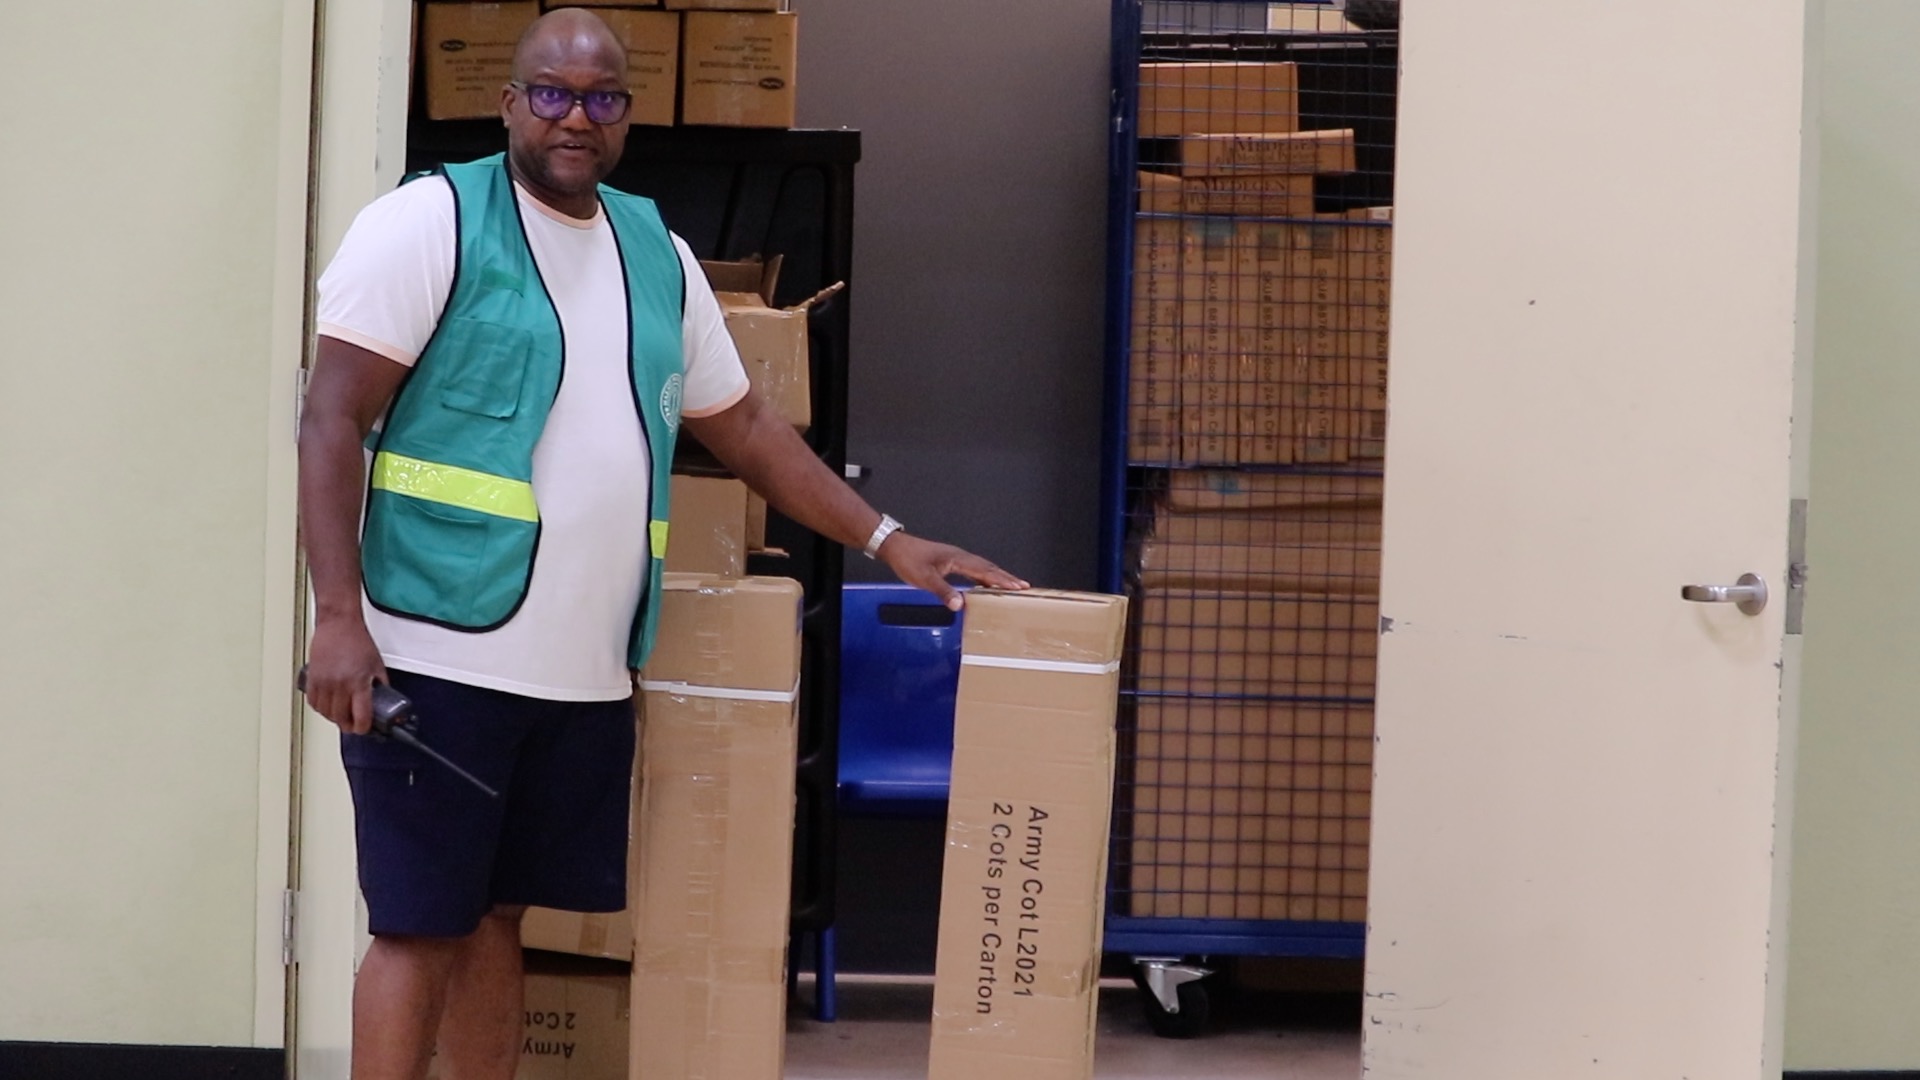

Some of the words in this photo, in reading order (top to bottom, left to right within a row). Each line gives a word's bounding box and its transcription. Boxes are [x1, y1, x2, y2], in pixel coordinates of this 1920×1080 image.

[993, 802, 1013, 815] 2
[988, 824, 1011, 878] Cots
[1020, 806, 1049, 870] Army
[982, 886, 1002, 926] per
[1020, 879, 1043, 920] Cot
[976, 933, 1002, 1015] Carton
[1014, 928, 1038, 997] L2021
[524, 1011, 560, 1029] Cot
[565, 1012, 576, 1029] 2
[523, 1037, 575, 1058] Army
